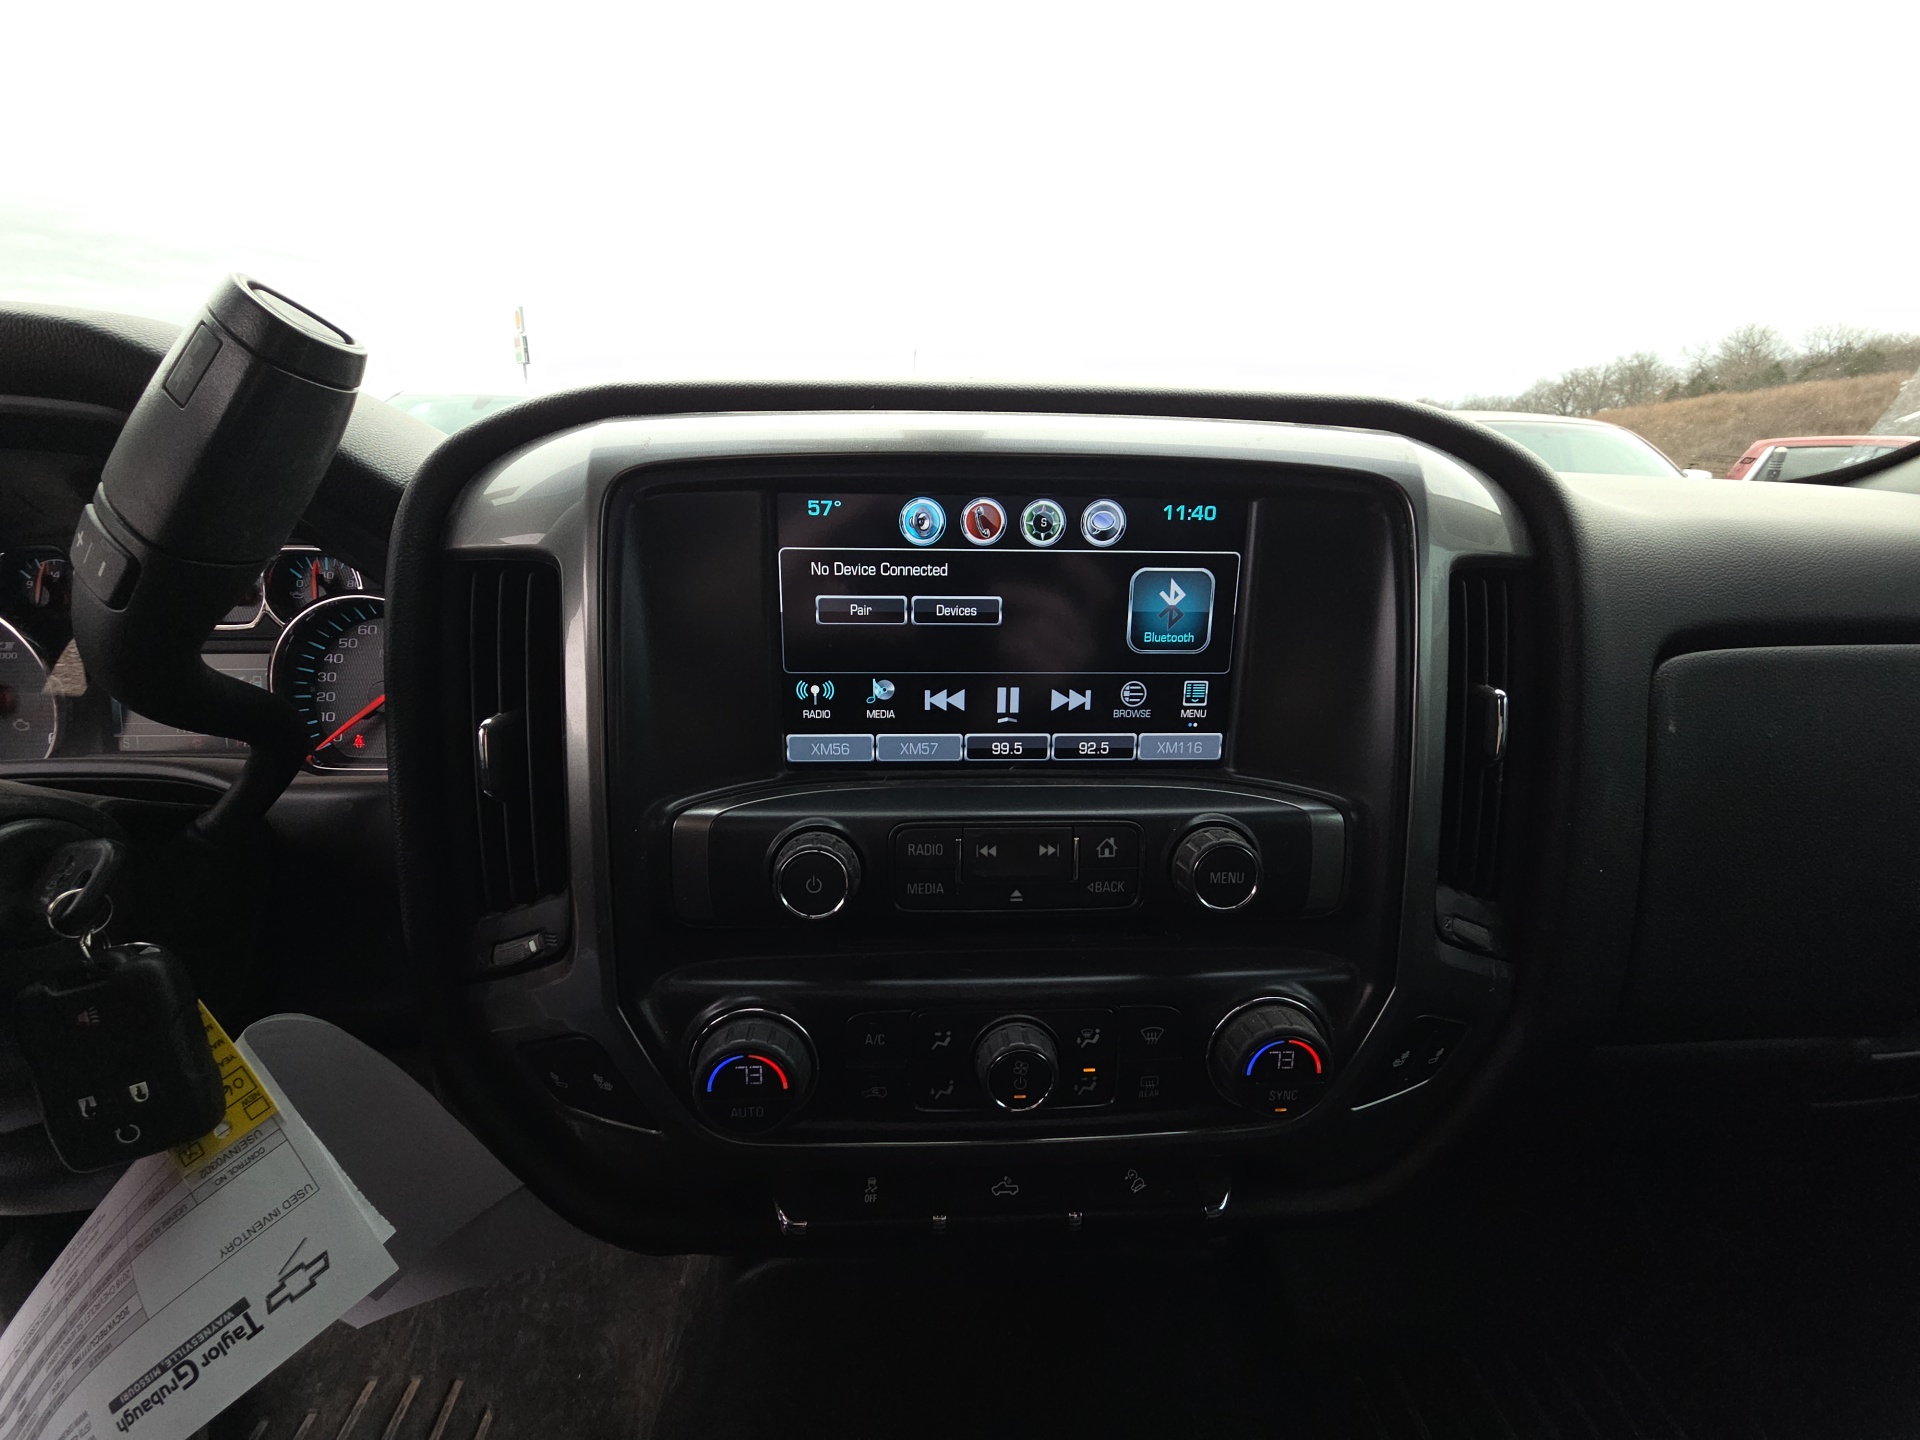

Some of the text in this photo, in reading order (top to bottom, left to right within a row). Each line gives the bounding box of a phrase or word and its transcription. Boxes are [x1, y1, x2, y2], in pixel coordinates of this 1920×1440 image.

[807, 499, 842, 517] 57°
[1163, 504, 1217, 522] 11:40
[810, 562, 948, 577] No Device Connected
[850, 603, 873, 616] Pair
[936, 605, 977, 617] Devices
[357, 625, 378, 636] 60
[338, 638, 358, 649] 50
[1144, 632, 1194, 644] Bluetooth
[324, 654, 344, 664] 40
[317, 672, 337, 683] 30
[316, 692, 336, 702] 20
[321, 712, 336, 722] 10
[803, 710, 831, 719] RADIO
[866, 709, 895, 718] MEDIA
[1113, 709, 1151, 718] BROWSE
[1180, 709, 1207, 718] MENU
[811, 743, 850, 756] XM56
[900, 743, 939, 755] XM57
[991, 742, 1023, 755] 99.5
[1078, 742, 1109, 755] 92.5
[1156, 741, 1203, 754] XM116
[907, 843, 944, 857] RADIO
[1209, 871, 1245, 885] MENU
[906, 881, 945, 895] MEDIA
[1094, 880, 1125, 894] BACK
[864, 1032, 886, 1046] A/C
[1269, 1050, 1295, 1069] 73
[735, 1064, 763, 1085] 73
[241, 1090, 261, 1108] NEW
[1138, 1089, 1160, 1099] REAR
[1268, 1089, 1298, 1101] SYNC
[730, 1106, 764, 1118] AUTO
[227, 1146, 266, 1177] CONTROL
[864, 1194, 877, 1203] OFF
[219, 1183, 314, 1259] USED INVENTORY
[201, 1311, 265, 1368] Taylor
[119, 1366, 162, 1404] MISSOURI
[115, 1358, 200, 1433] Grubaugh
